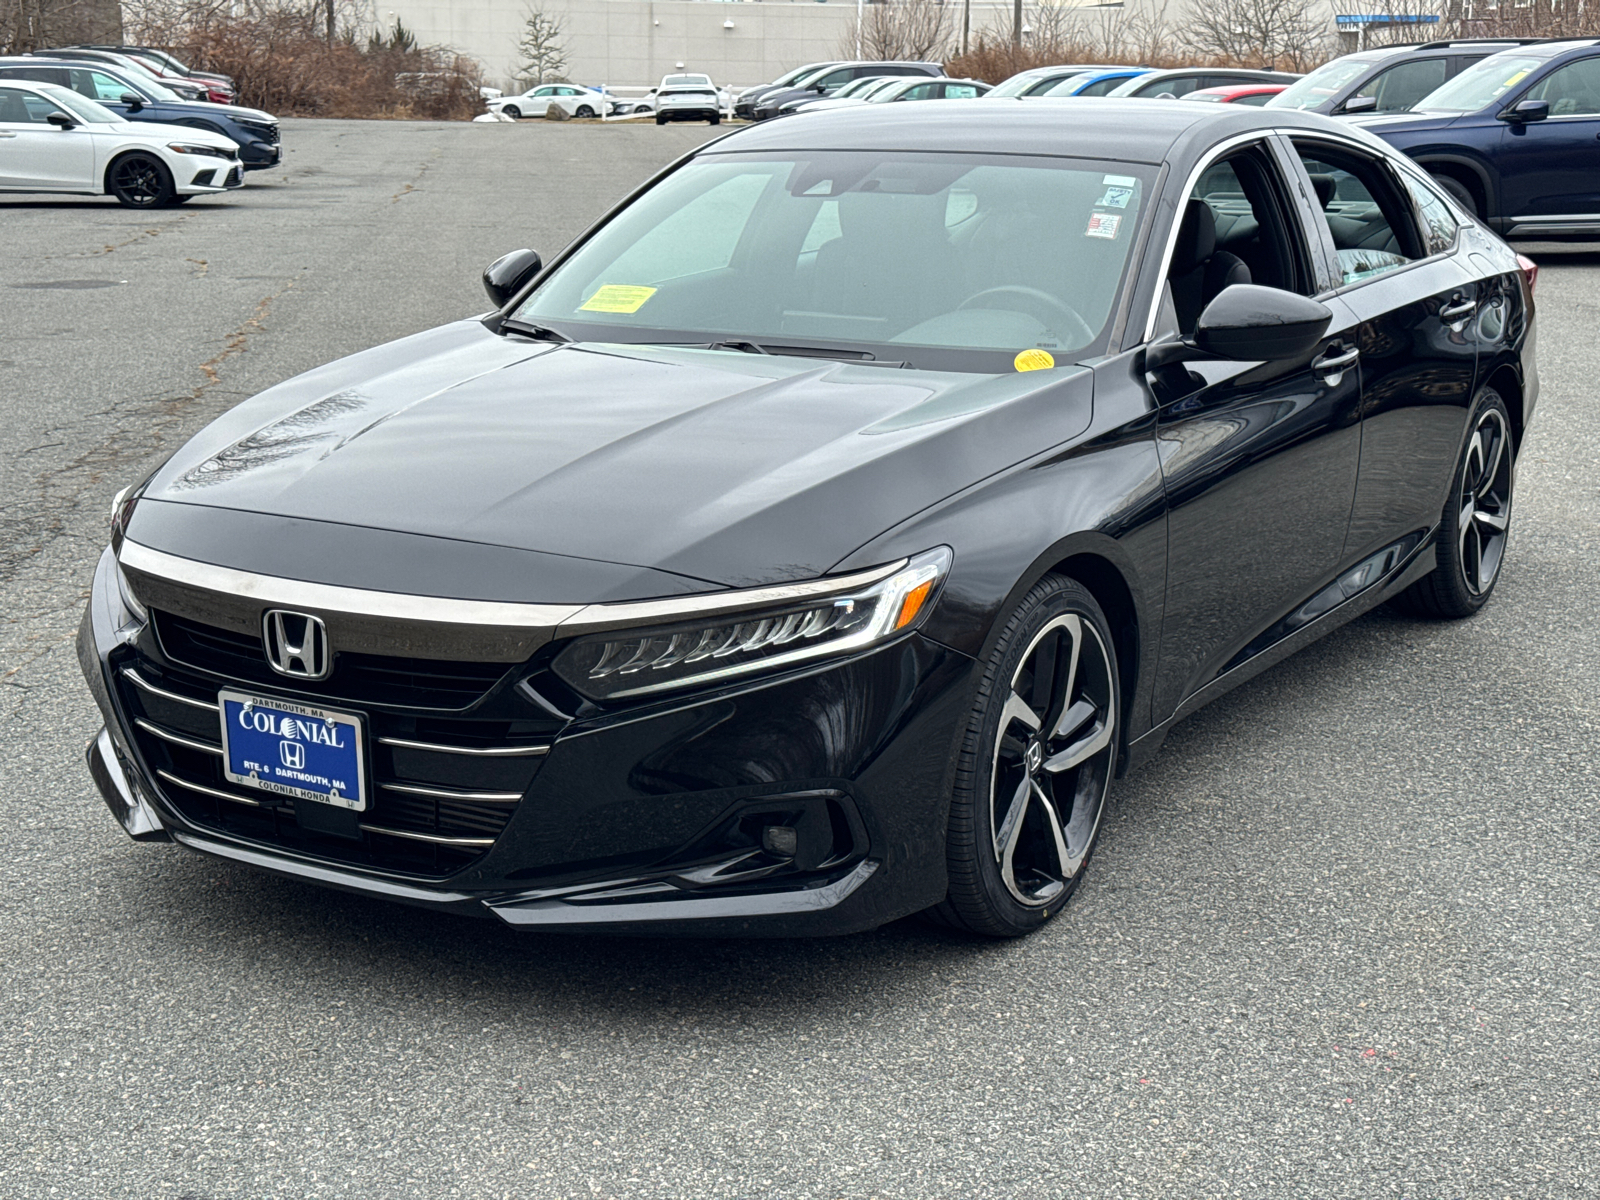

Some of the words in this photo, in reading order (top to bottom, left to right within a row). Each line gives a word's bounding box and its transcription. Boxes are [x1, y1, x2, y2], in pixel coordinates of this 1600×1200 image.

[311, 709, 325, 718] MA
[239, 709, 344, 748] COLONIAL
[243, 760, 262, 772] RTE.
[263, 765, 270, 773] 6
[275, 767, 331, 788] DARTMOUTH,
[332, 780, 346, 790] MA
[258, 780, 299, 797] COLONIAL
[300, 790, 330, 803] HONDA
